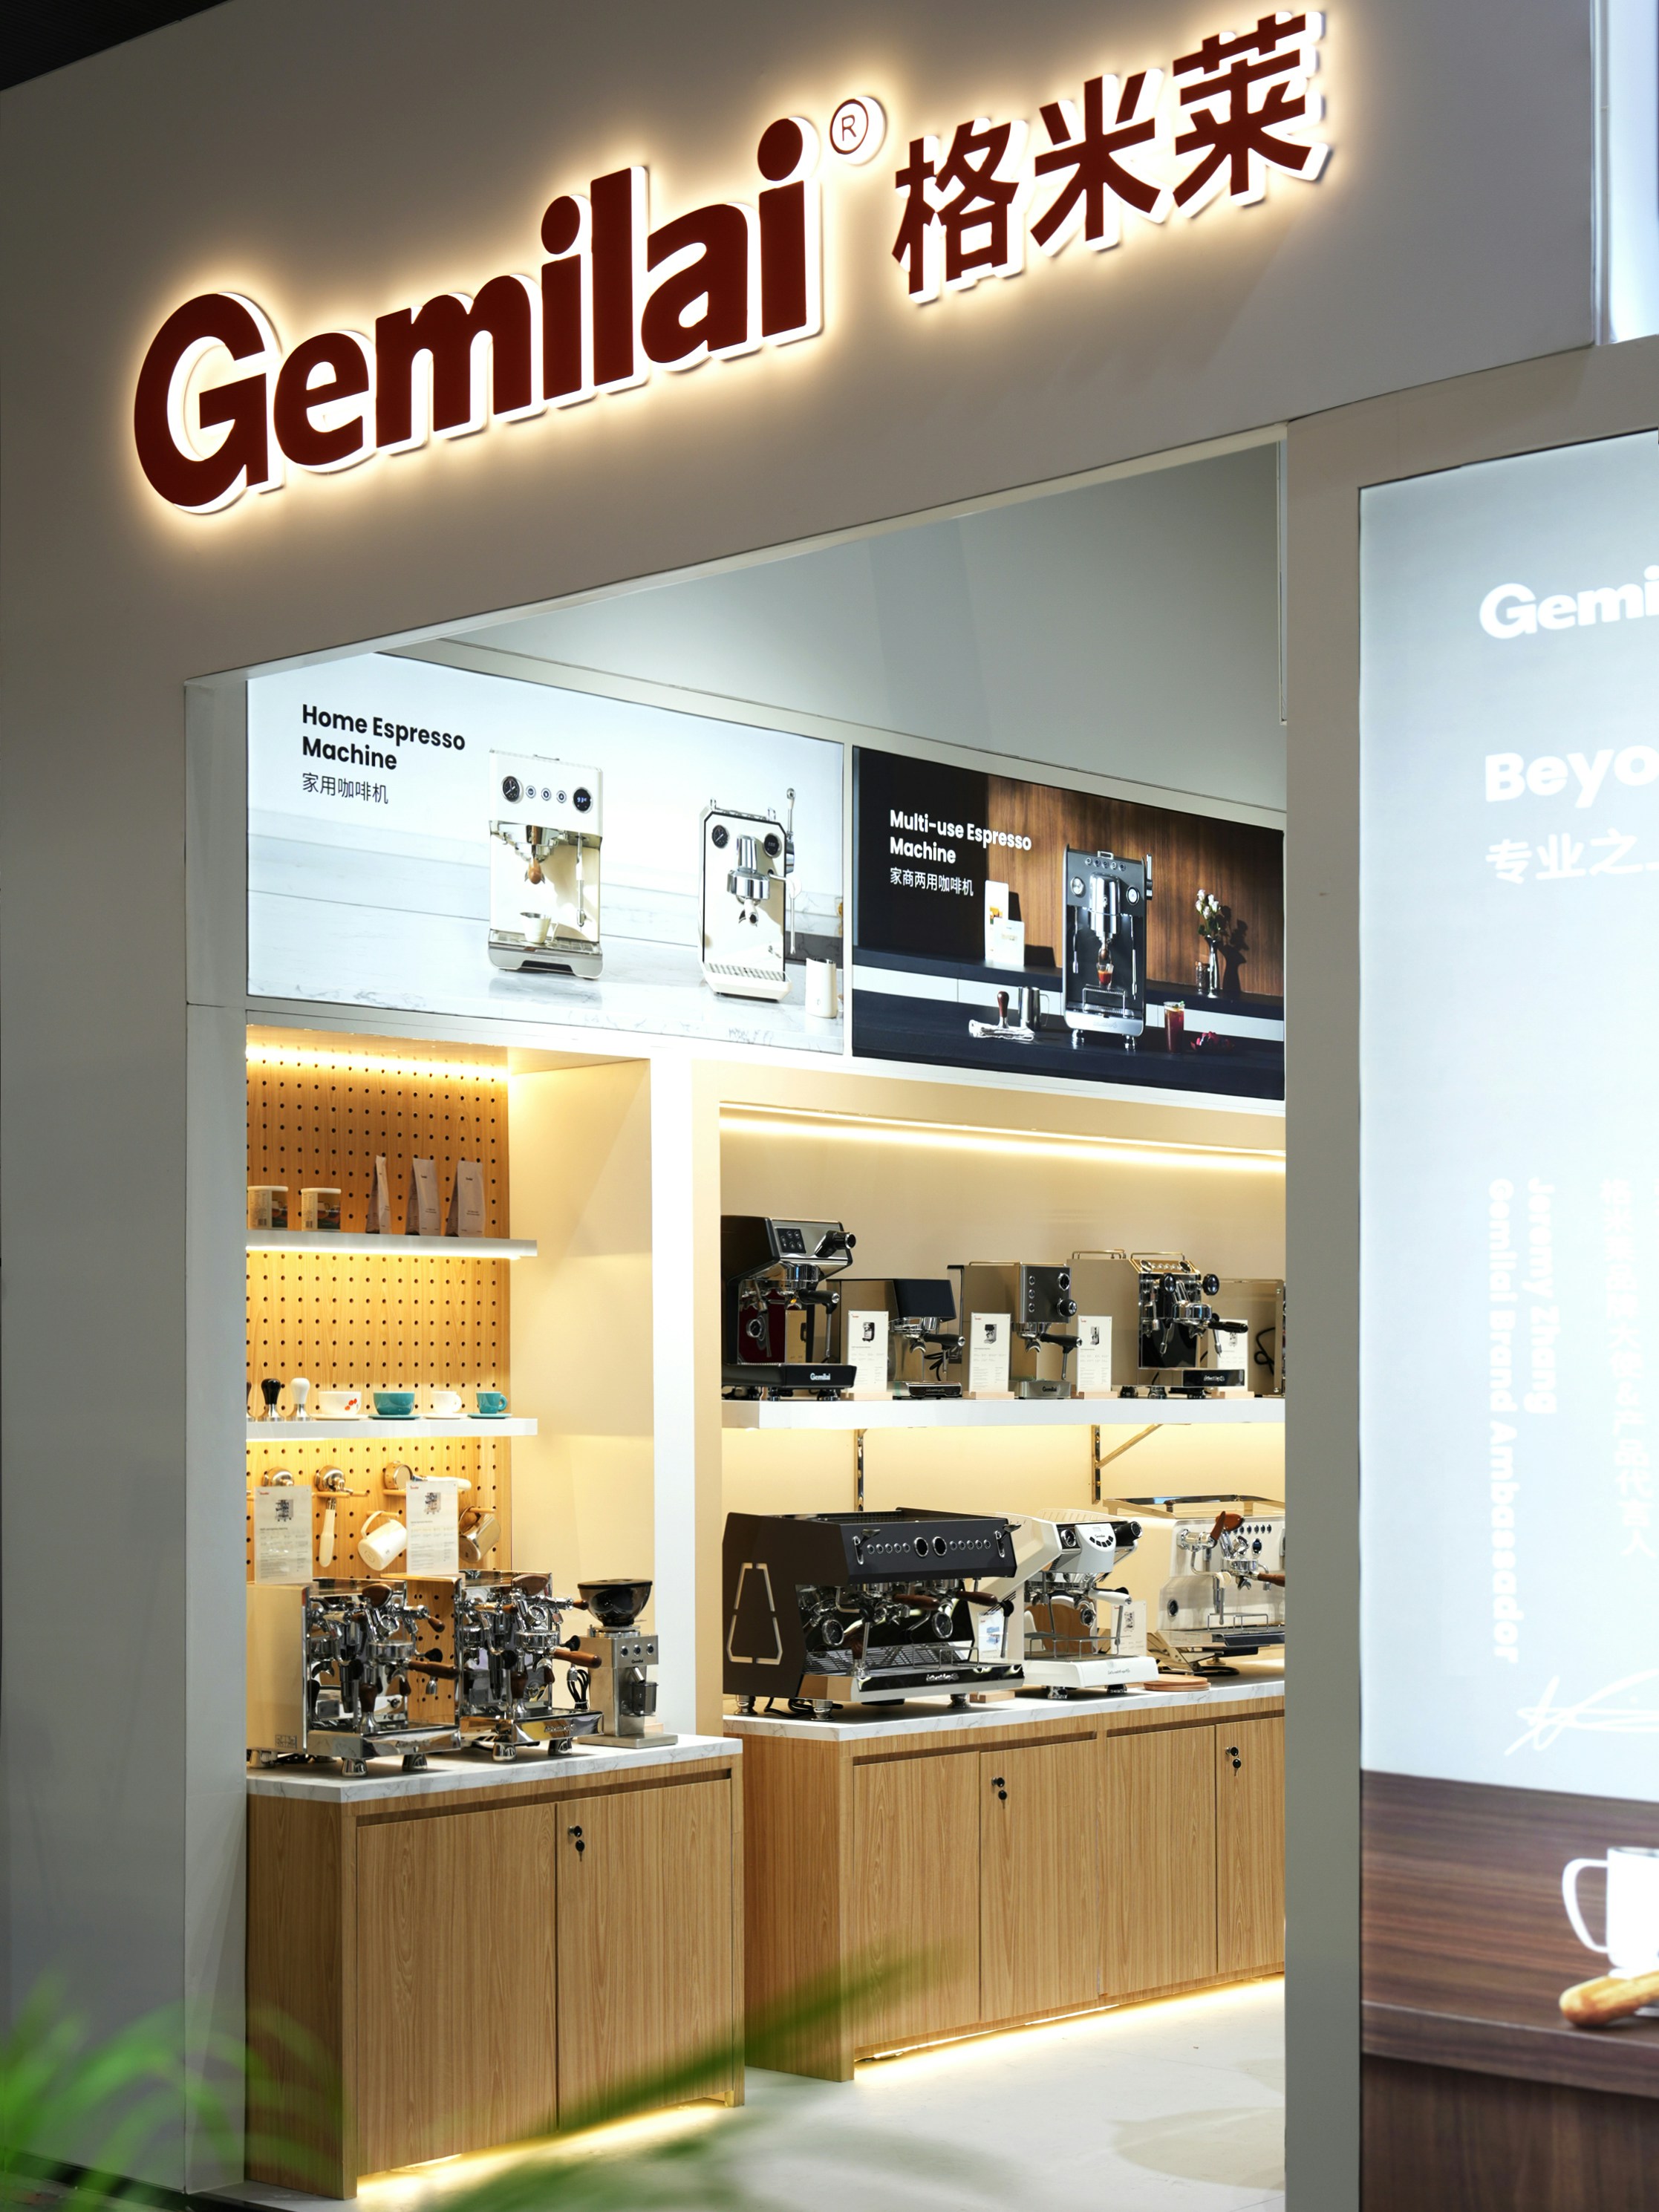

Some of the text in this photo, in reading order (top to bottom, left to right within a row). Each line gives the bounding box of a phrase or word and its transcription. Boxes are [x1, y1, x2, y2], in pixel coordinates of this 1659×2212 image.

[892, 13, 1318, 297] 格米莱
[134, 117, 815, 509] Gemilai
[302, 704, 466, 751] Home Espresso
[302, 736, 397, 770] Machine
[302, 771, 388, 804] 家用咖啡机
[1485, 745, 1659, 809] Beyo
[890, 809, 1032, 851] Multi-use Espresso
[890, 836, 956, 864] Machine
[890, 867, 974, 897] 家商两用咖啡机
[1522, 1176, 1562, 1415] Jeremy Zhang
[1488, 1178, 1525, 1664] Gemilai Brand Ambassador
